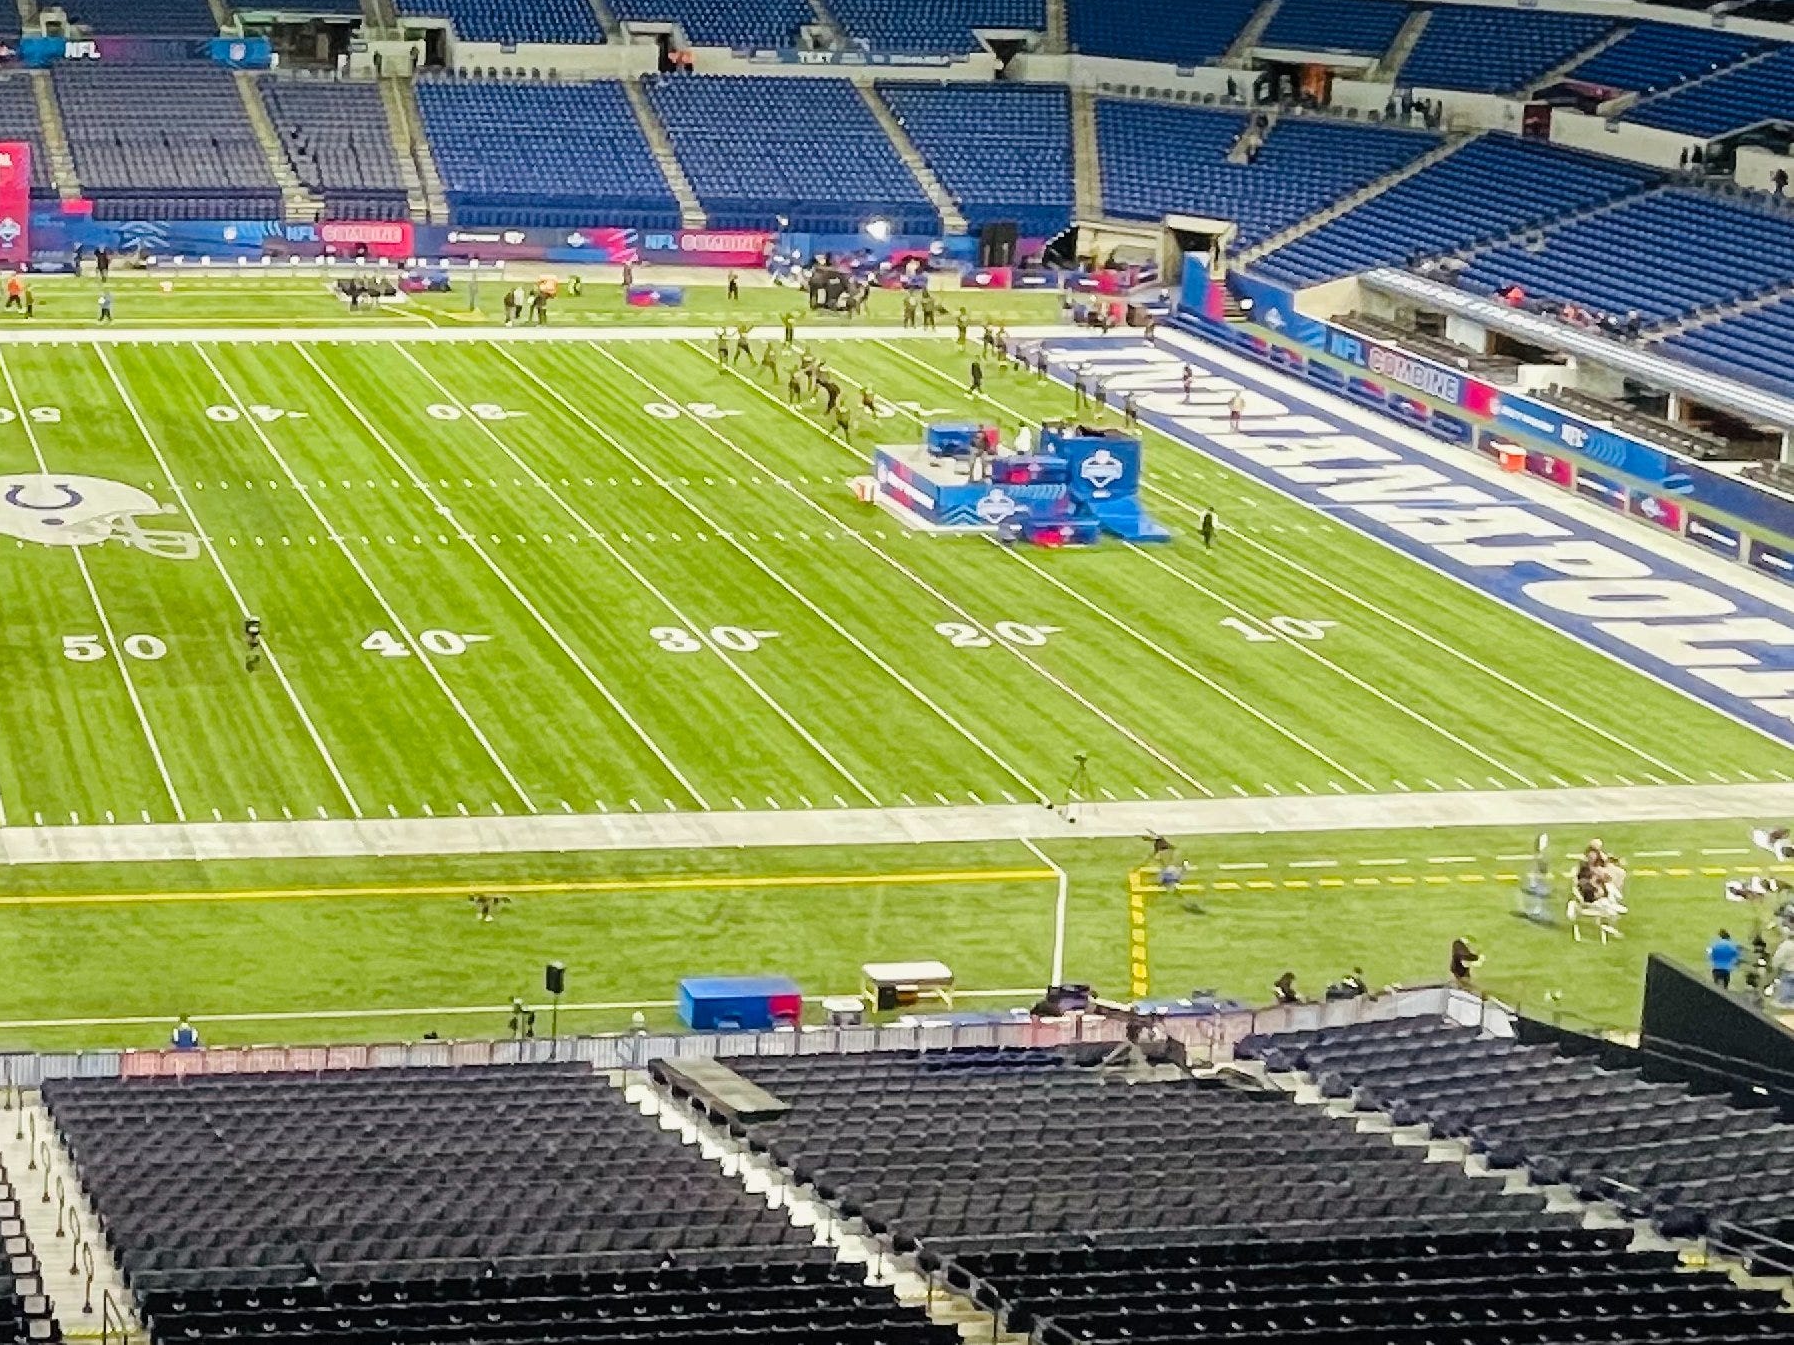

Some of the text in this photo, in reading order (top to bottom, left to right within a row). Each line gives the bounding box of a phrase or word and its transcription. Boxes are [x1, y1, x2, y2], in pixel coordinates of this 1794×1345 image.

[65, 40, 101, 58] NFL
[286, 226, 320, 242] NFL
[644, 235, 679, 250] NFL
[1331, 329, 1459, 404] NFL COMBINE
[1042, 347, 1794, 722] INDIANAPOL
[649, 626, 760, 653] 30
[933, 620, 1046, 648] 20
[1220, 615, 1324, 643] 10
[62, 634, 168, 662] 50
[361, 629, 468, 658] 40
